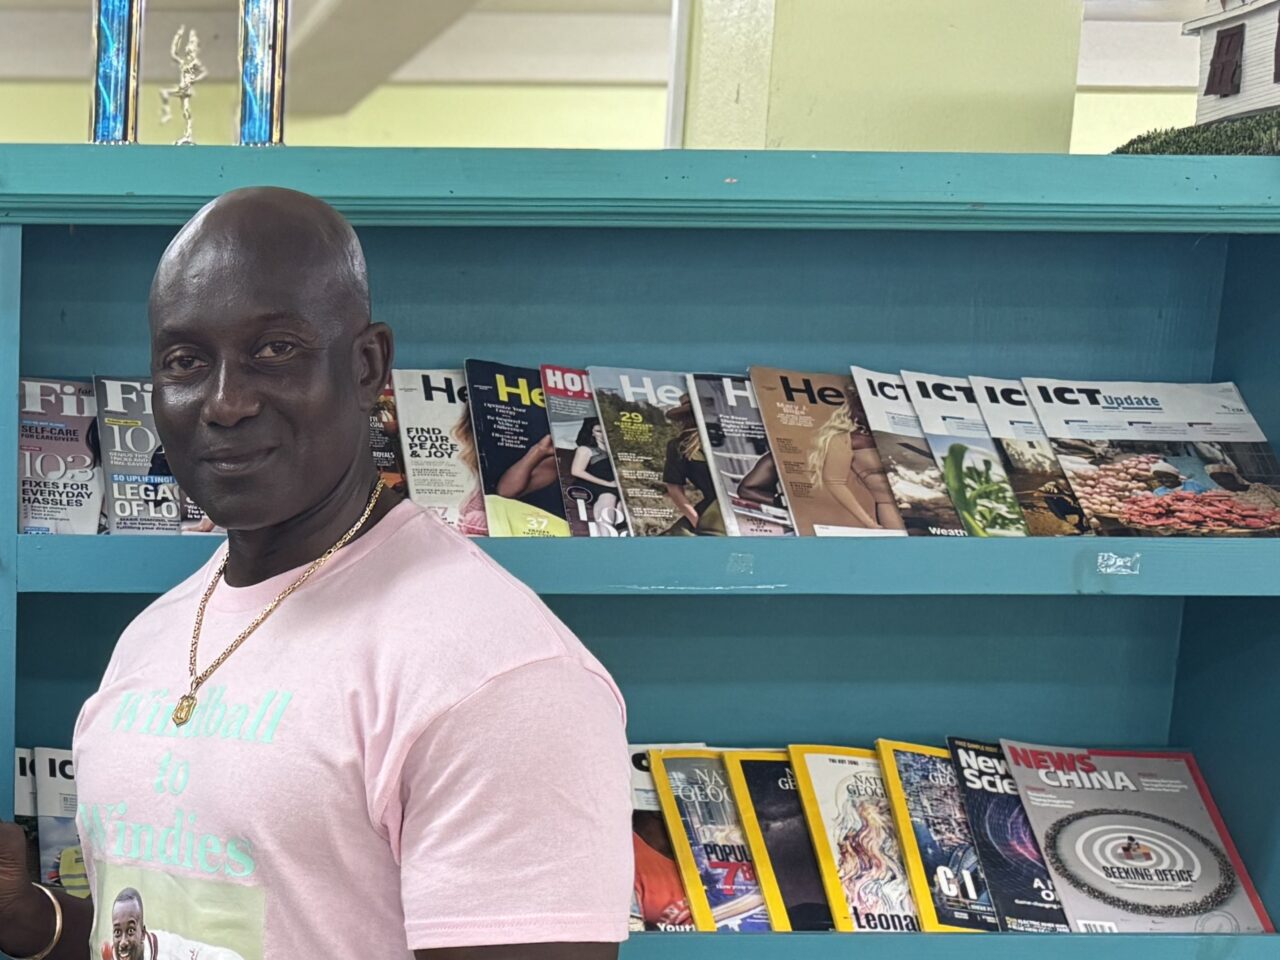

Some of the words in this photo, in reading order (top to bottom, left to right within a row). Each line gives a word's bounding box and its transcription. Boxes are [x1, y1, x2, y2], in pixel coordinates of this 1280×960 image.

[619, 374, 681, 407] He
[779, 375, 845, 406] He
[1036, 385, 1102, 406] ICT
[1102, 394, 1161, 408] Update
[619, 411, 643, 423] 29
[20, 425, 80, 437] SELF-CARE
[407, 427, 442, 436] FIND
[407, 434, 449, 444] YOUR
[408, 443, 459, 452] PEACE
[425, 450, 453, 459] JOY
[113, 474, 125, 482] SO
[21, 480, 59, 490] FIXES
[63, 482, 89, 491] FOR
[21, 488, 93, 499] EVERYDAY
[21, 497, 83, 507] HASSLES
[114, 500, 144, 517] OF
[526, 516, 548, 529] 37
[1008, 746, 1098, 773] NEWS
[153, 749, 191, 797] to
[1038, 766, 1140, 792] CHINA
[928, 773, 957, 787] GEO
[963, 768, 1019, 795] Scie
[78, 800, 257, 878] Windies
[1102, 865, 1153, 882] SEEKING
[1154, 867, 1196, 883] OFFICE
